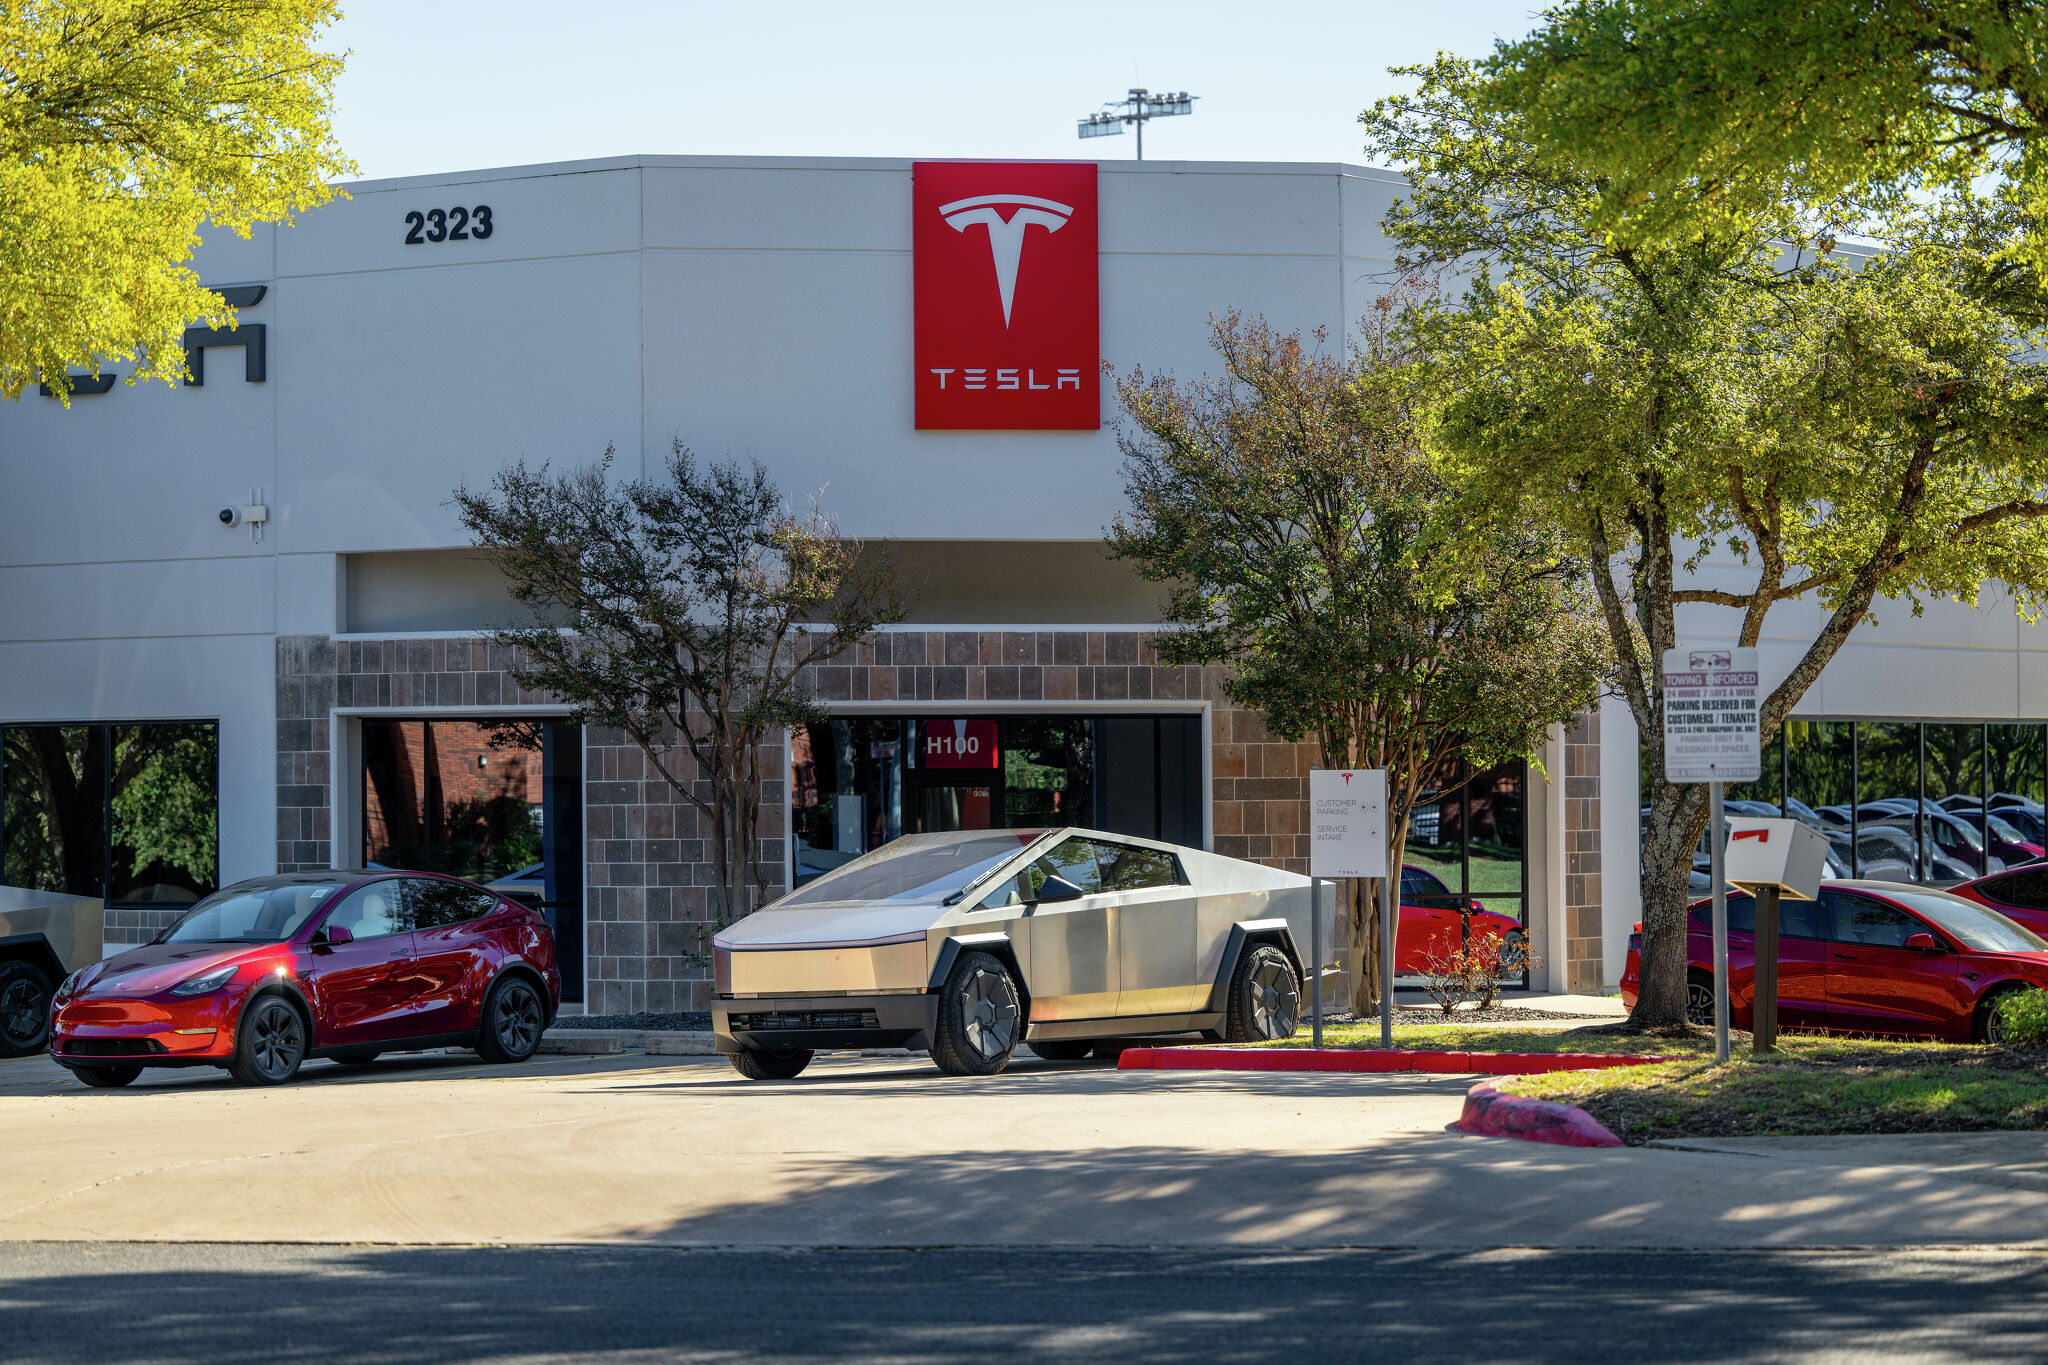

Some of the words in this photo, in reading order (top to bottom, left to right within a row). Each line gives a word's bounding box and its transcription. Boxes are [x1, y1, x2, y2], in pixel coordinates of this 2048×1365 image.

[405, 205, 494, 245] 2323
[930, 368, 1080, 390] TESLA
[1666, 675, 1702, 686] TOWING
[1705, 673, 1757, 685] ENFORCED
[1667, 689, 1676, 698] 24
[1678, 689, 1700, 698] HOURS
[1710, 688, 1727, 697] DAYS
[1729, 688, 1734, 697] A
[1736, 688, 1755, 697] WEEK
[1667, 700, 1700, 711] PARKING
[1702, 699, 1739, 710] RESERVED
[1742, 699, 1756, 710] FOR
[1667, 713, 1713, 724] CUSTOMERS
[1721, 713, 1756, 724] TENANTS
[1680, 735, 1713, 743] PARKING
[1714, 735, 1732, 743] ONLY
[927, 736, 980, 755] H100
[1675, 745, 1719, 754] DESIGNATED
[1721, 744, 1749, 753] SPACES
[1316, 799, 1357, 807] CUSTOMER
[1316, 808, 1349, 816] PARKING
[1317, 825, 1347, 833] SERVICE
[1317, 833, 1343, 841] INTAKE
